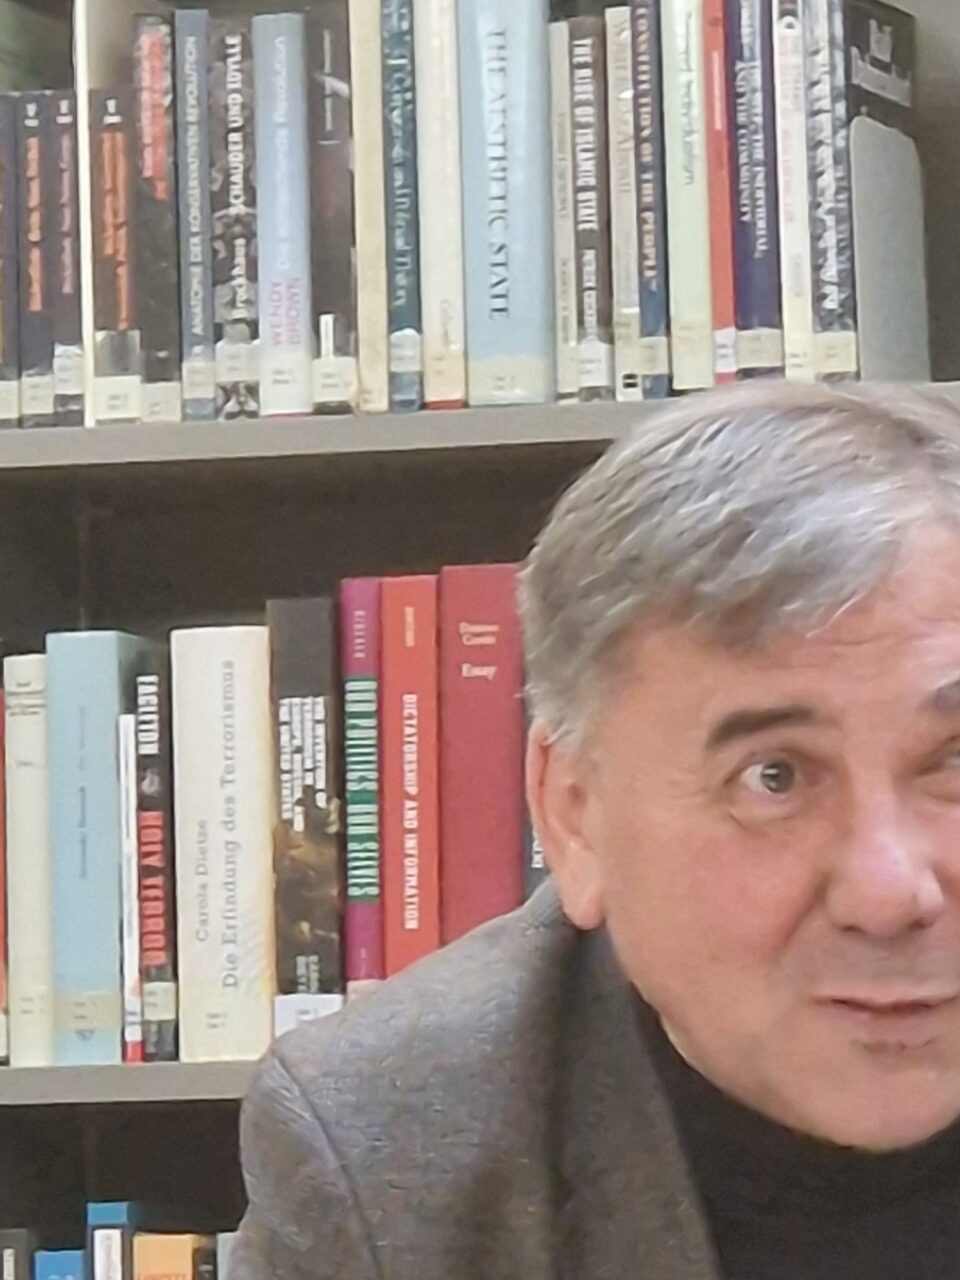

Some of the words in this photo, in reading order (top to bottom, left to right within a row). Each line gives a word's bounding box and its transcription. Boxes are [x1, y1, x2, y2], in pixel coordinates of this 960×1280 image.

[184, 36, 200, 122] REVOLUTION
[225, 34, 242, 89] IDYLLE
[487, 29, 508, 75] THE
[571, 38, 592, 64] THE
[227, 95, 244, 126] UND
[573, 69, 594, 101] RISE
[574, 107, 595, 124] OF
[228, 132, 246, 214] SCHAUDER
[575, 128, 597, 186] ISLAMIC
[577, 192, 598, 231] STATE
[190, 234, 204, 261] DER
[489, 243, 510, 320] STATE
[270, 280, 284, 345] WENDY
[288, 277, 302, 345] BROWN
[218, 659, 237, 788] Terrorismus
[402, 694, 419, 796] DICTATORSHIP
[345, 719, 379, 791] POLITICS
[140, 810, 165, 867] HOLY
[221, 795, 237, 832] des
[404, 800, 419, 829] AND
[195, 819, 209, 876] Dietze
[347, 842, 380, 896] SELVES
[221, 840, 241, 945] Erfindung
[404, 834, 420, 929] INFORMATION
[195, 882, 210, 942] Carola
[222, 952, 239, 988] Die
